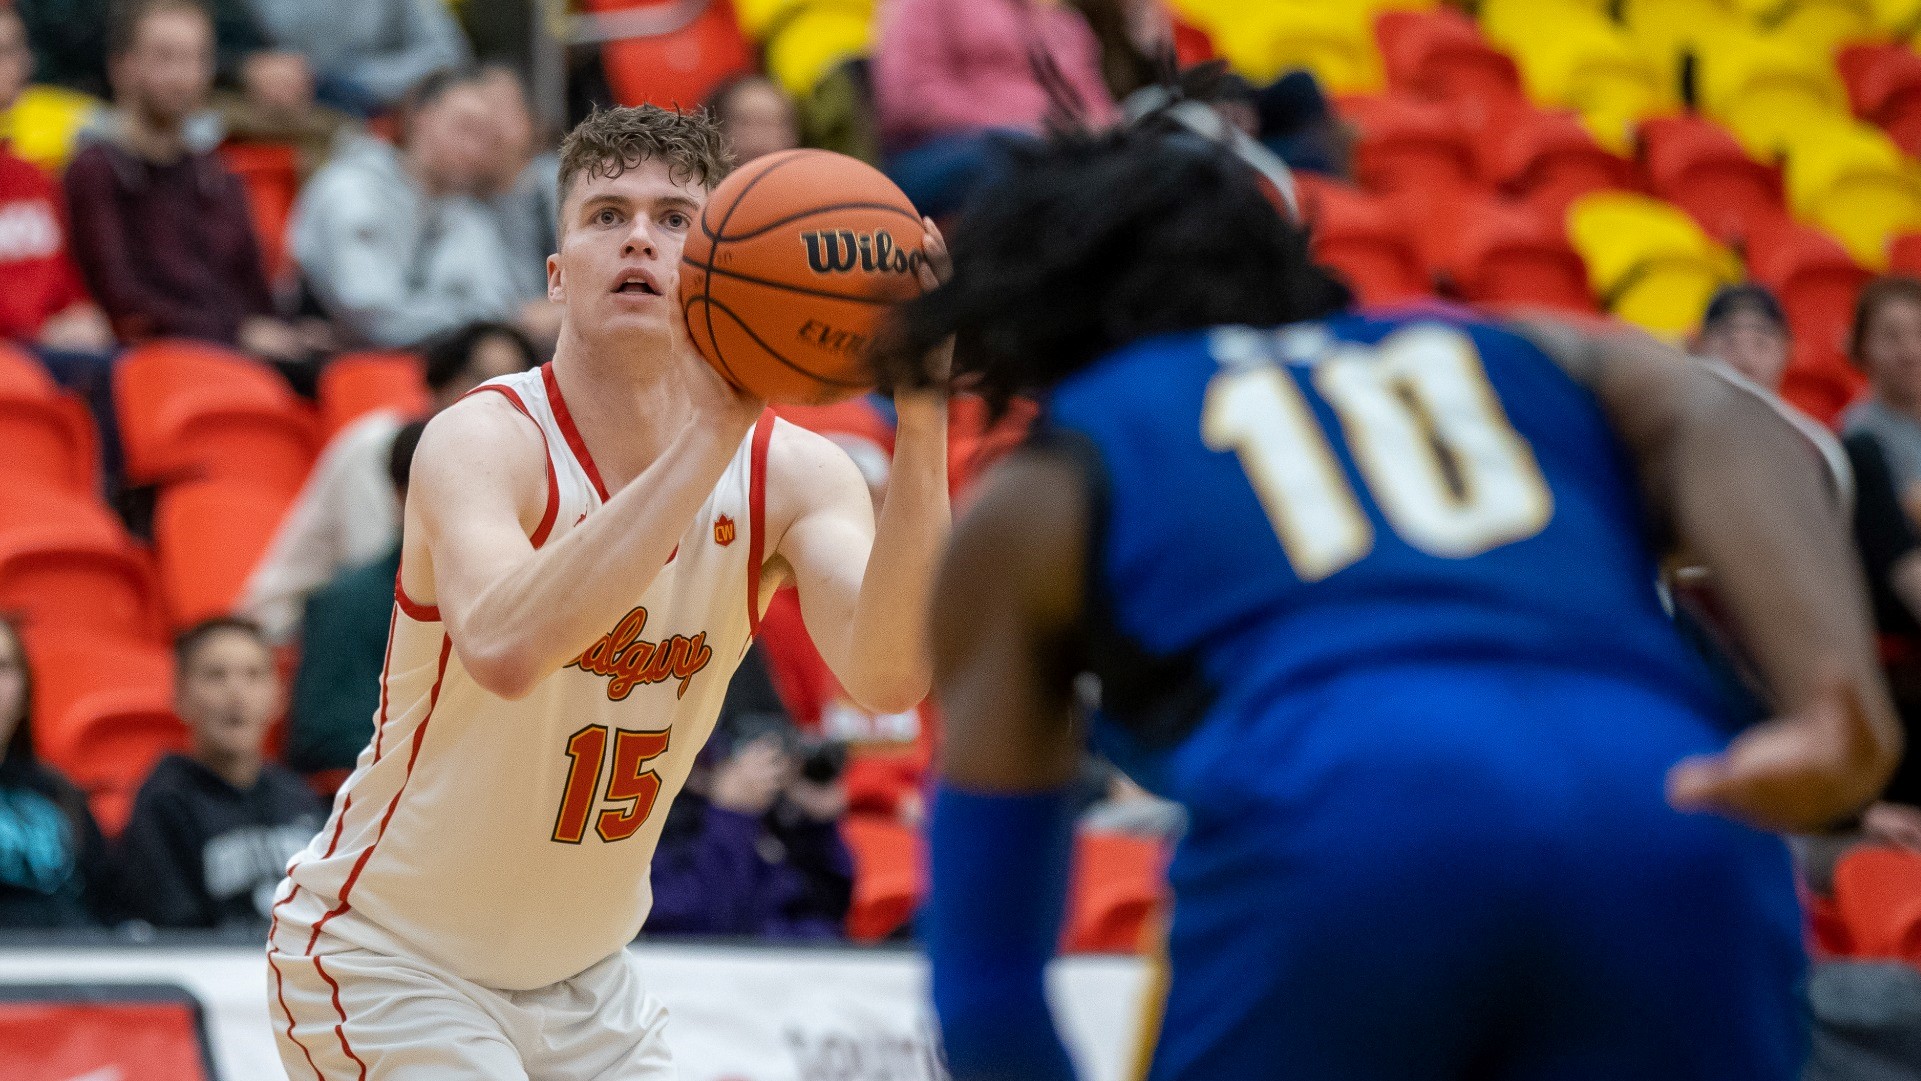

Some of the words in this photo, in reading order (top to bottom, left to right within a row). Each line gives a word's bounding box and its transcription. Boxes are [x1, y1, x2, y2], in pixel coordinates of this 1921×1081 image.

[800, 229, 923, 275] Wilso
[1201, 321, 1555, 582] 10
[715, 523, 734, 542] CW
[563, 606, 712, 701] algary
[551, 723, 673, 845] 15
